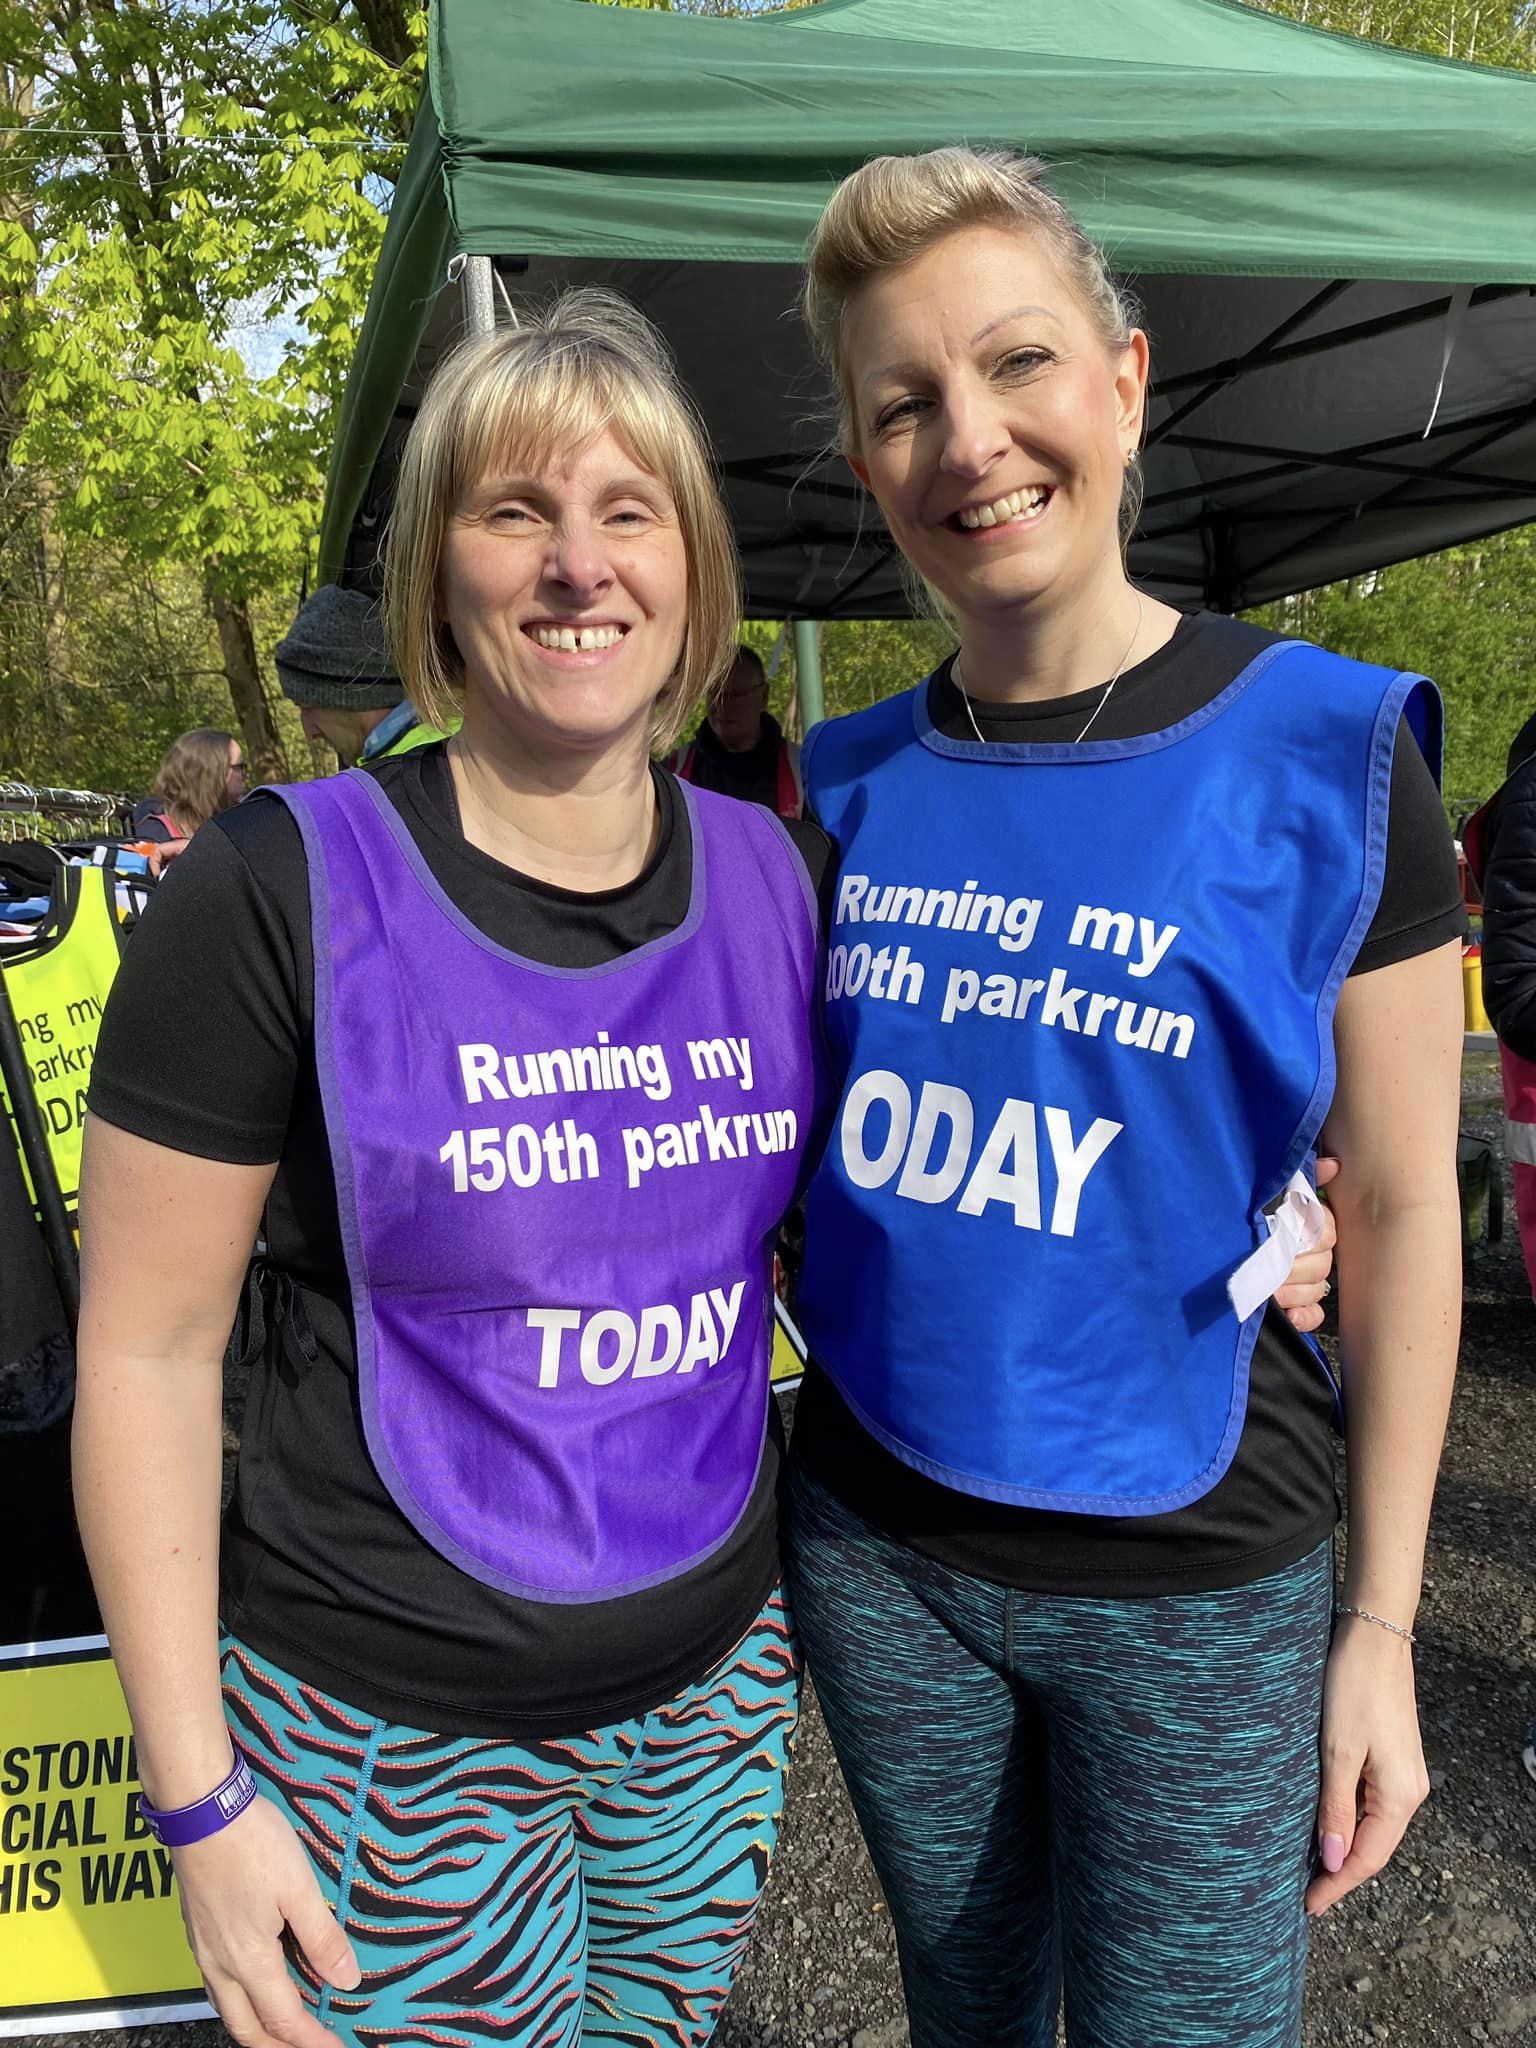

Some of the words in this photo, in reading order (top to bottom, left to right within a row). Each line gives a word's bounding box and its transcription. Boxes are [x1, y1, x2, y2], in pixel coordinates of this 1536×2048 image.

[836, 874, 1044, 952] Running
[1068, 904, 1181, 978] my
[941, 968, 1195, 1059] parkrun
[27, 1044, 95, 1086] arkr
[457, 1031, 672, 1103] Running
[686, 1035, 754, 1091] my
[438, 1119, 600, 1193] 150th
[621, 1104, 798, 1189] parkrun
[841, 1069, 1124, 1238] ODAY
[526, 1281, 746, 1388] TODAY
[2, 1797, 107, 1854] CIAL
[80, 1848, 175, 1906] WAY
